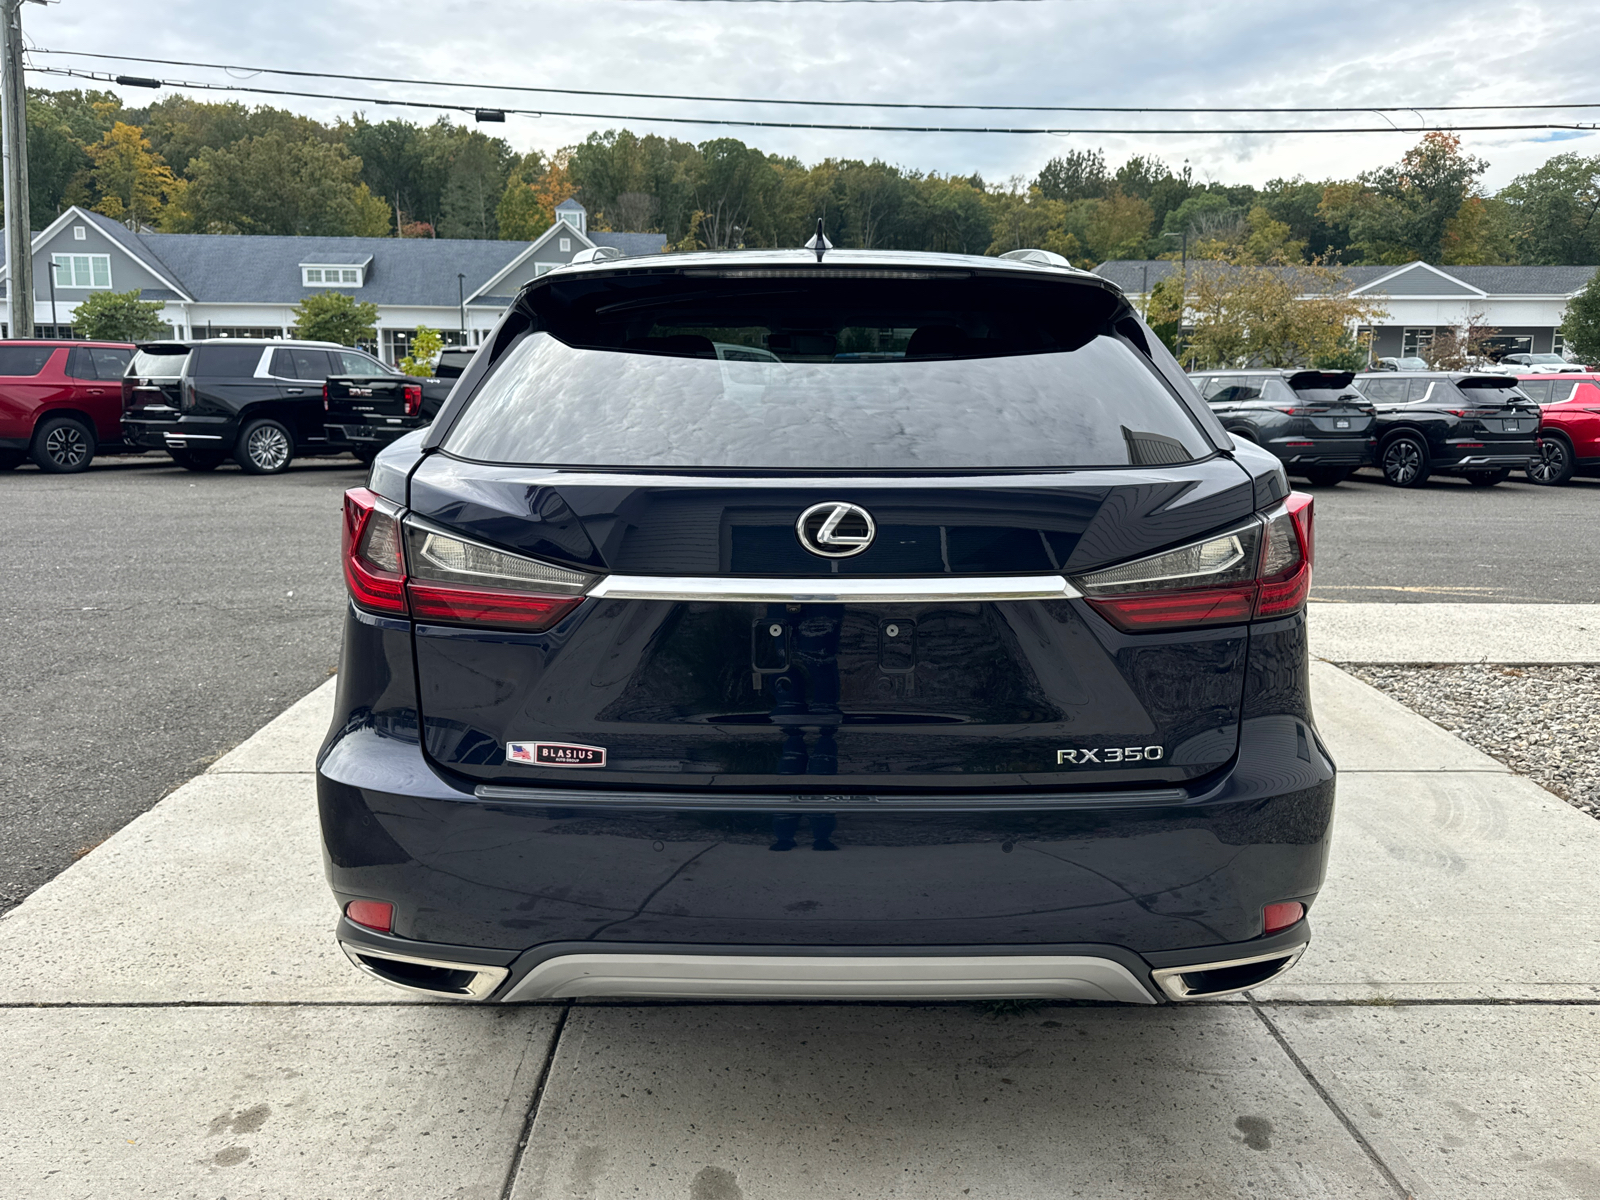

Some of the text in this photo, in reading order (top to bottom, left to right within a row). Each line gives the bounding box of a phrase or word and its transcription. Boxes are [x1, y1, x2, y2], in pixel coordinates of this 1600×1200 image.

[542, 748, 593, 760] BLASIUS
[1057, 745, 1164, 765] RX 350
